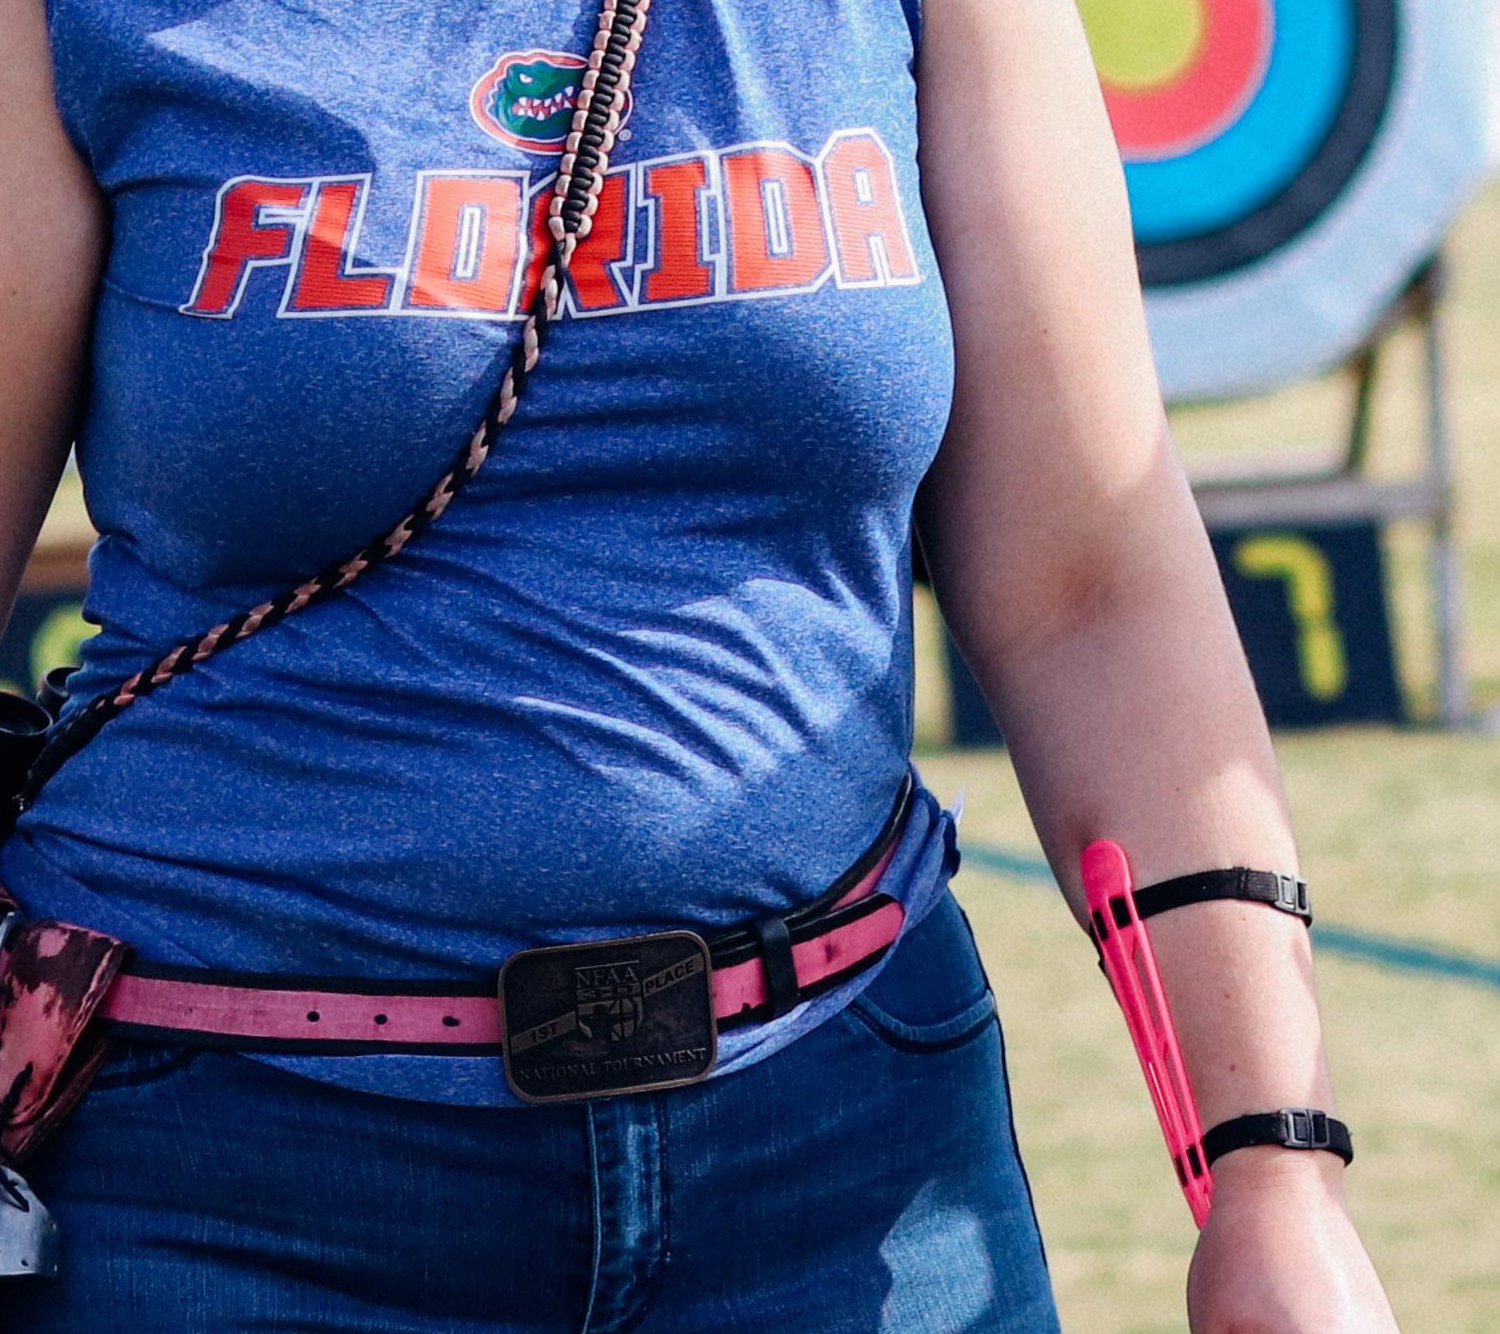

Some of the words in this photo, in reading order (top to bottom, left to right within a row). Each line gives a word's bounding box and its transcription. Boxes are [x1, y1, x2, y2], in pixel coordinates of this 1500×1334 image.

[179, 126, 922, 320] FLORIDA
[530, 1022, 558, 1044] 1ST
[645, 961, 696, 993] PLACE
[577, 966, 639, 987] NFAA
[519, 1061, 597, 1082] NATIONAL
[603, 1048, 707, 1074] TOURNAMENT
